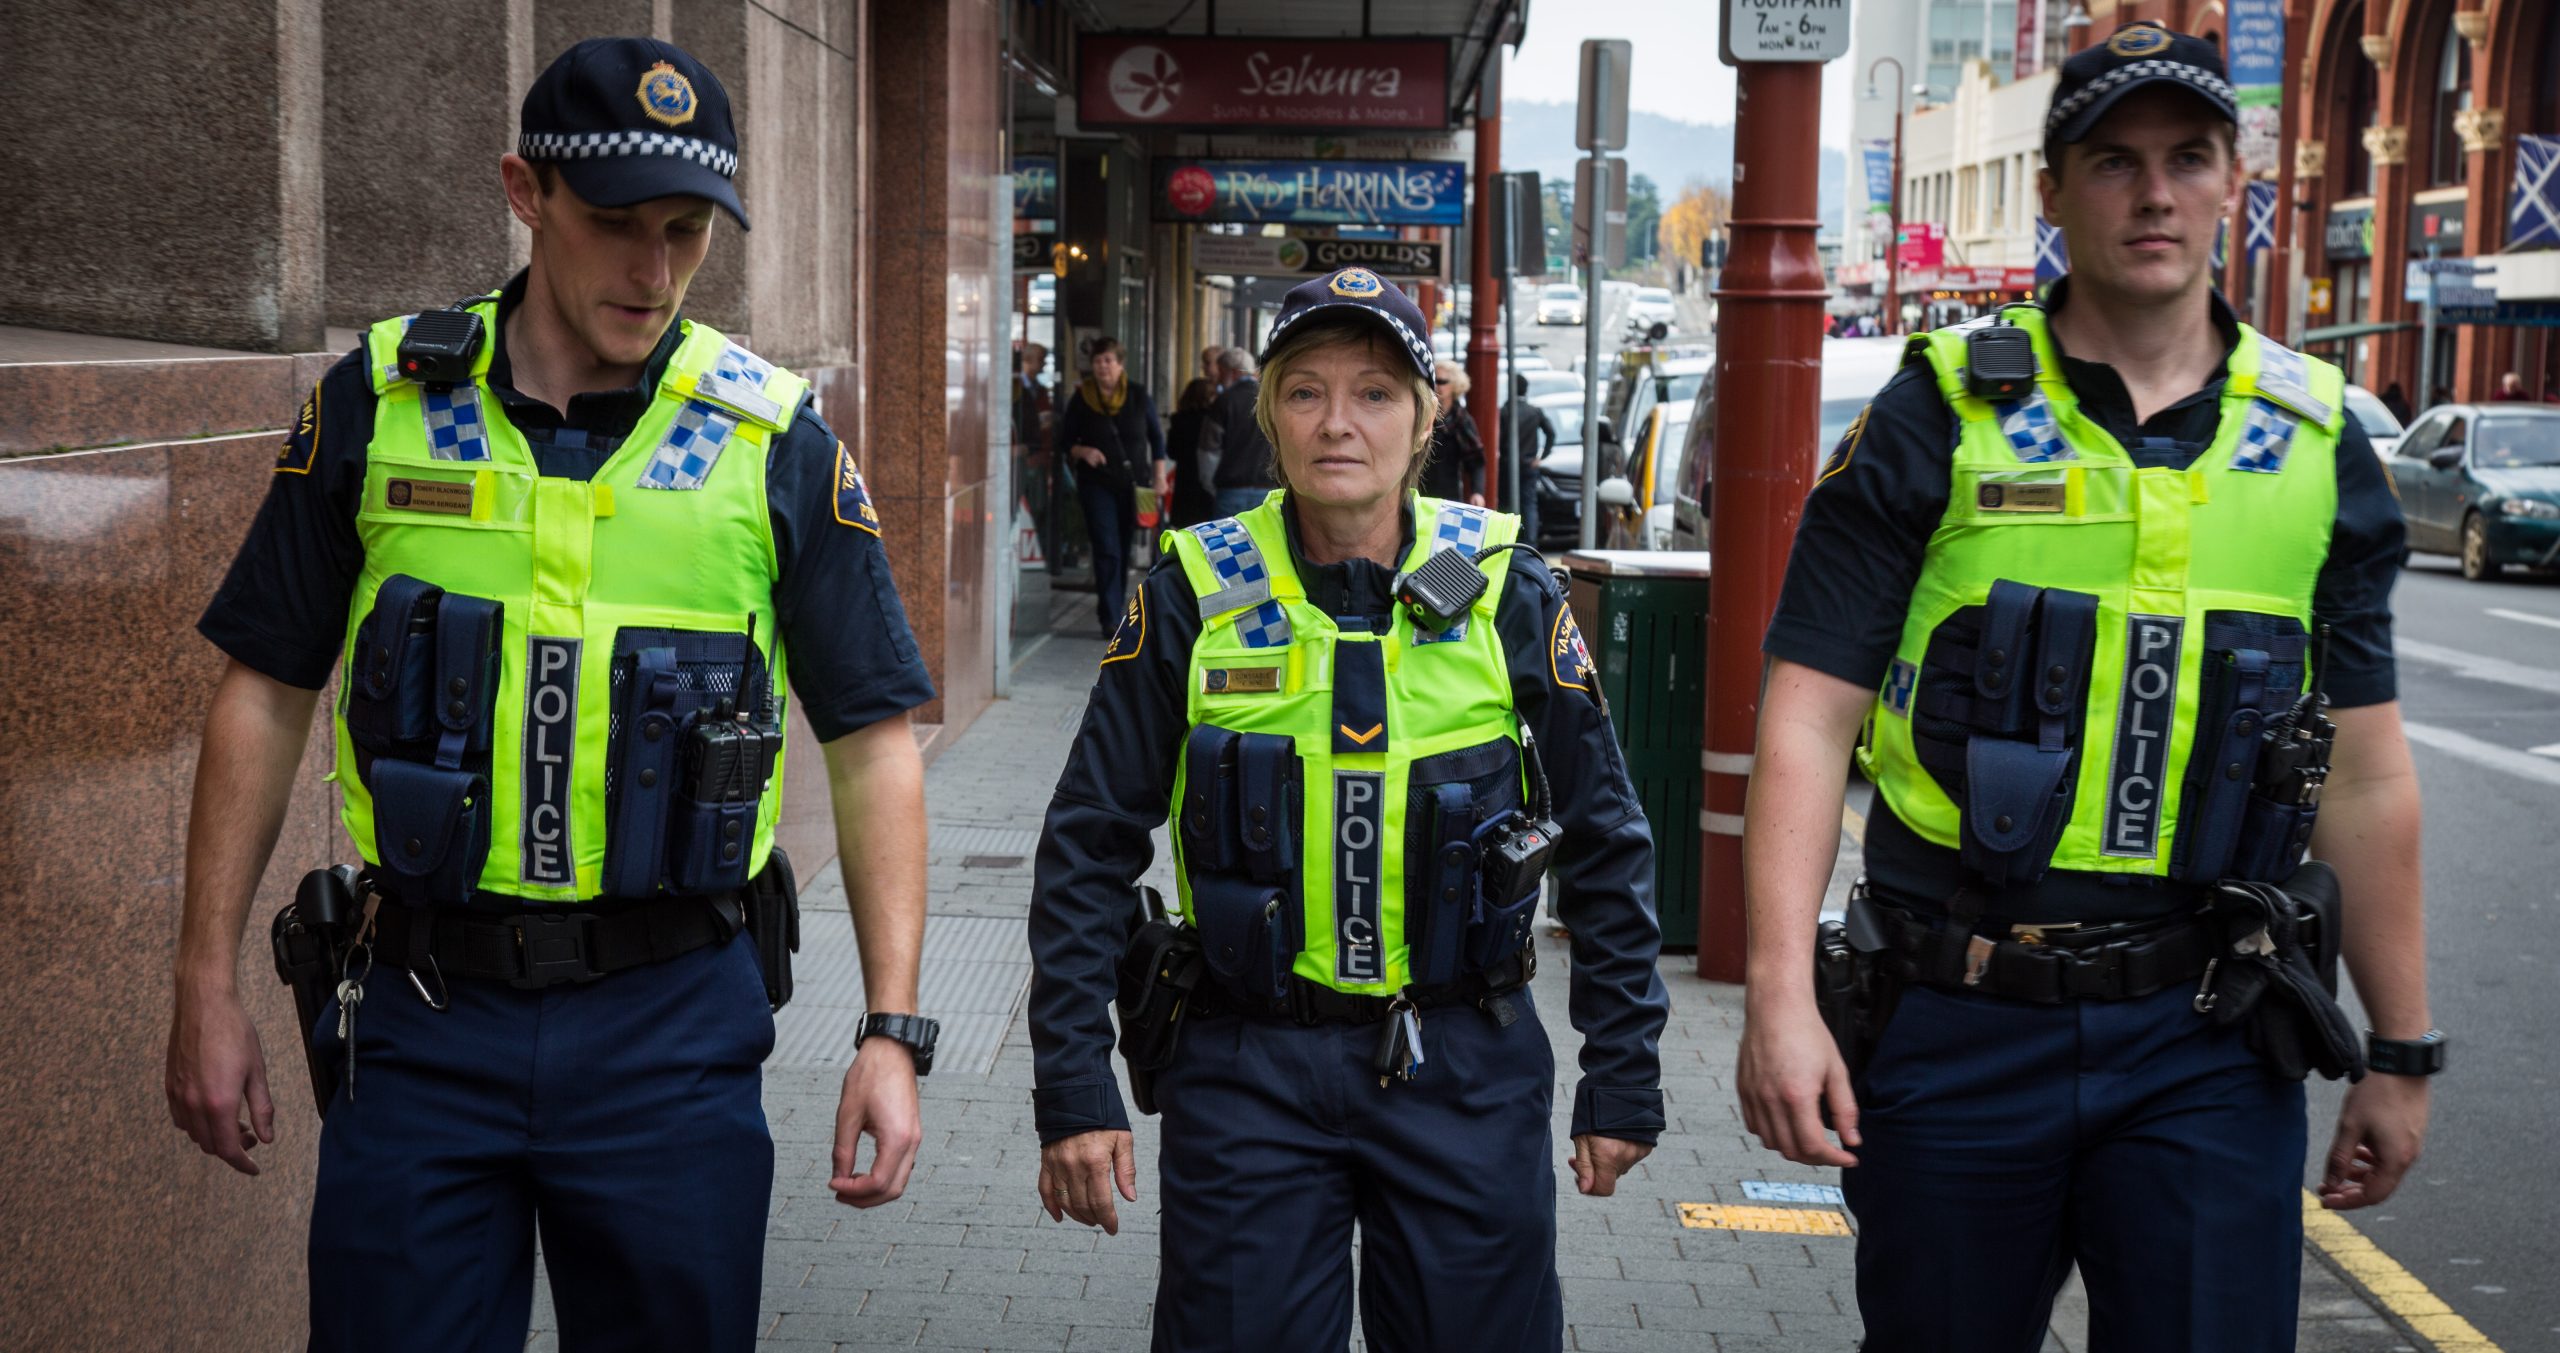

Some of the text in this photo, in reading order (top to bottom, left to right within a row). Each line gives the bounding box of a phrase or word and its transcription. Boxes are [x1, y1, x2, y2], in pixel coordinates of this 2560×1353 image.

[1756, 12, 1779, 34] 7AM
[1799, 13, 1826, 35] 6PM
[1758, 41, 1821, 50] MON SAT
[1239, 51, 1402, 98] Sakura
[1212, 103, 1253, 119] Sushi
[1258, 104, 1270, 119] &
[1275, 104, 1343, 120] Noodles
[1348, 105, 1360, 120] &
[1317, 242, 1432, 268] GOULDS
[412, 498, 470, 509] SENIOR SERGEANT
[2116, 624, 2172, 847] POLICE
[532, 645, 568, 879] POLICE
[1341, 780, 1374, 976] POLICE
